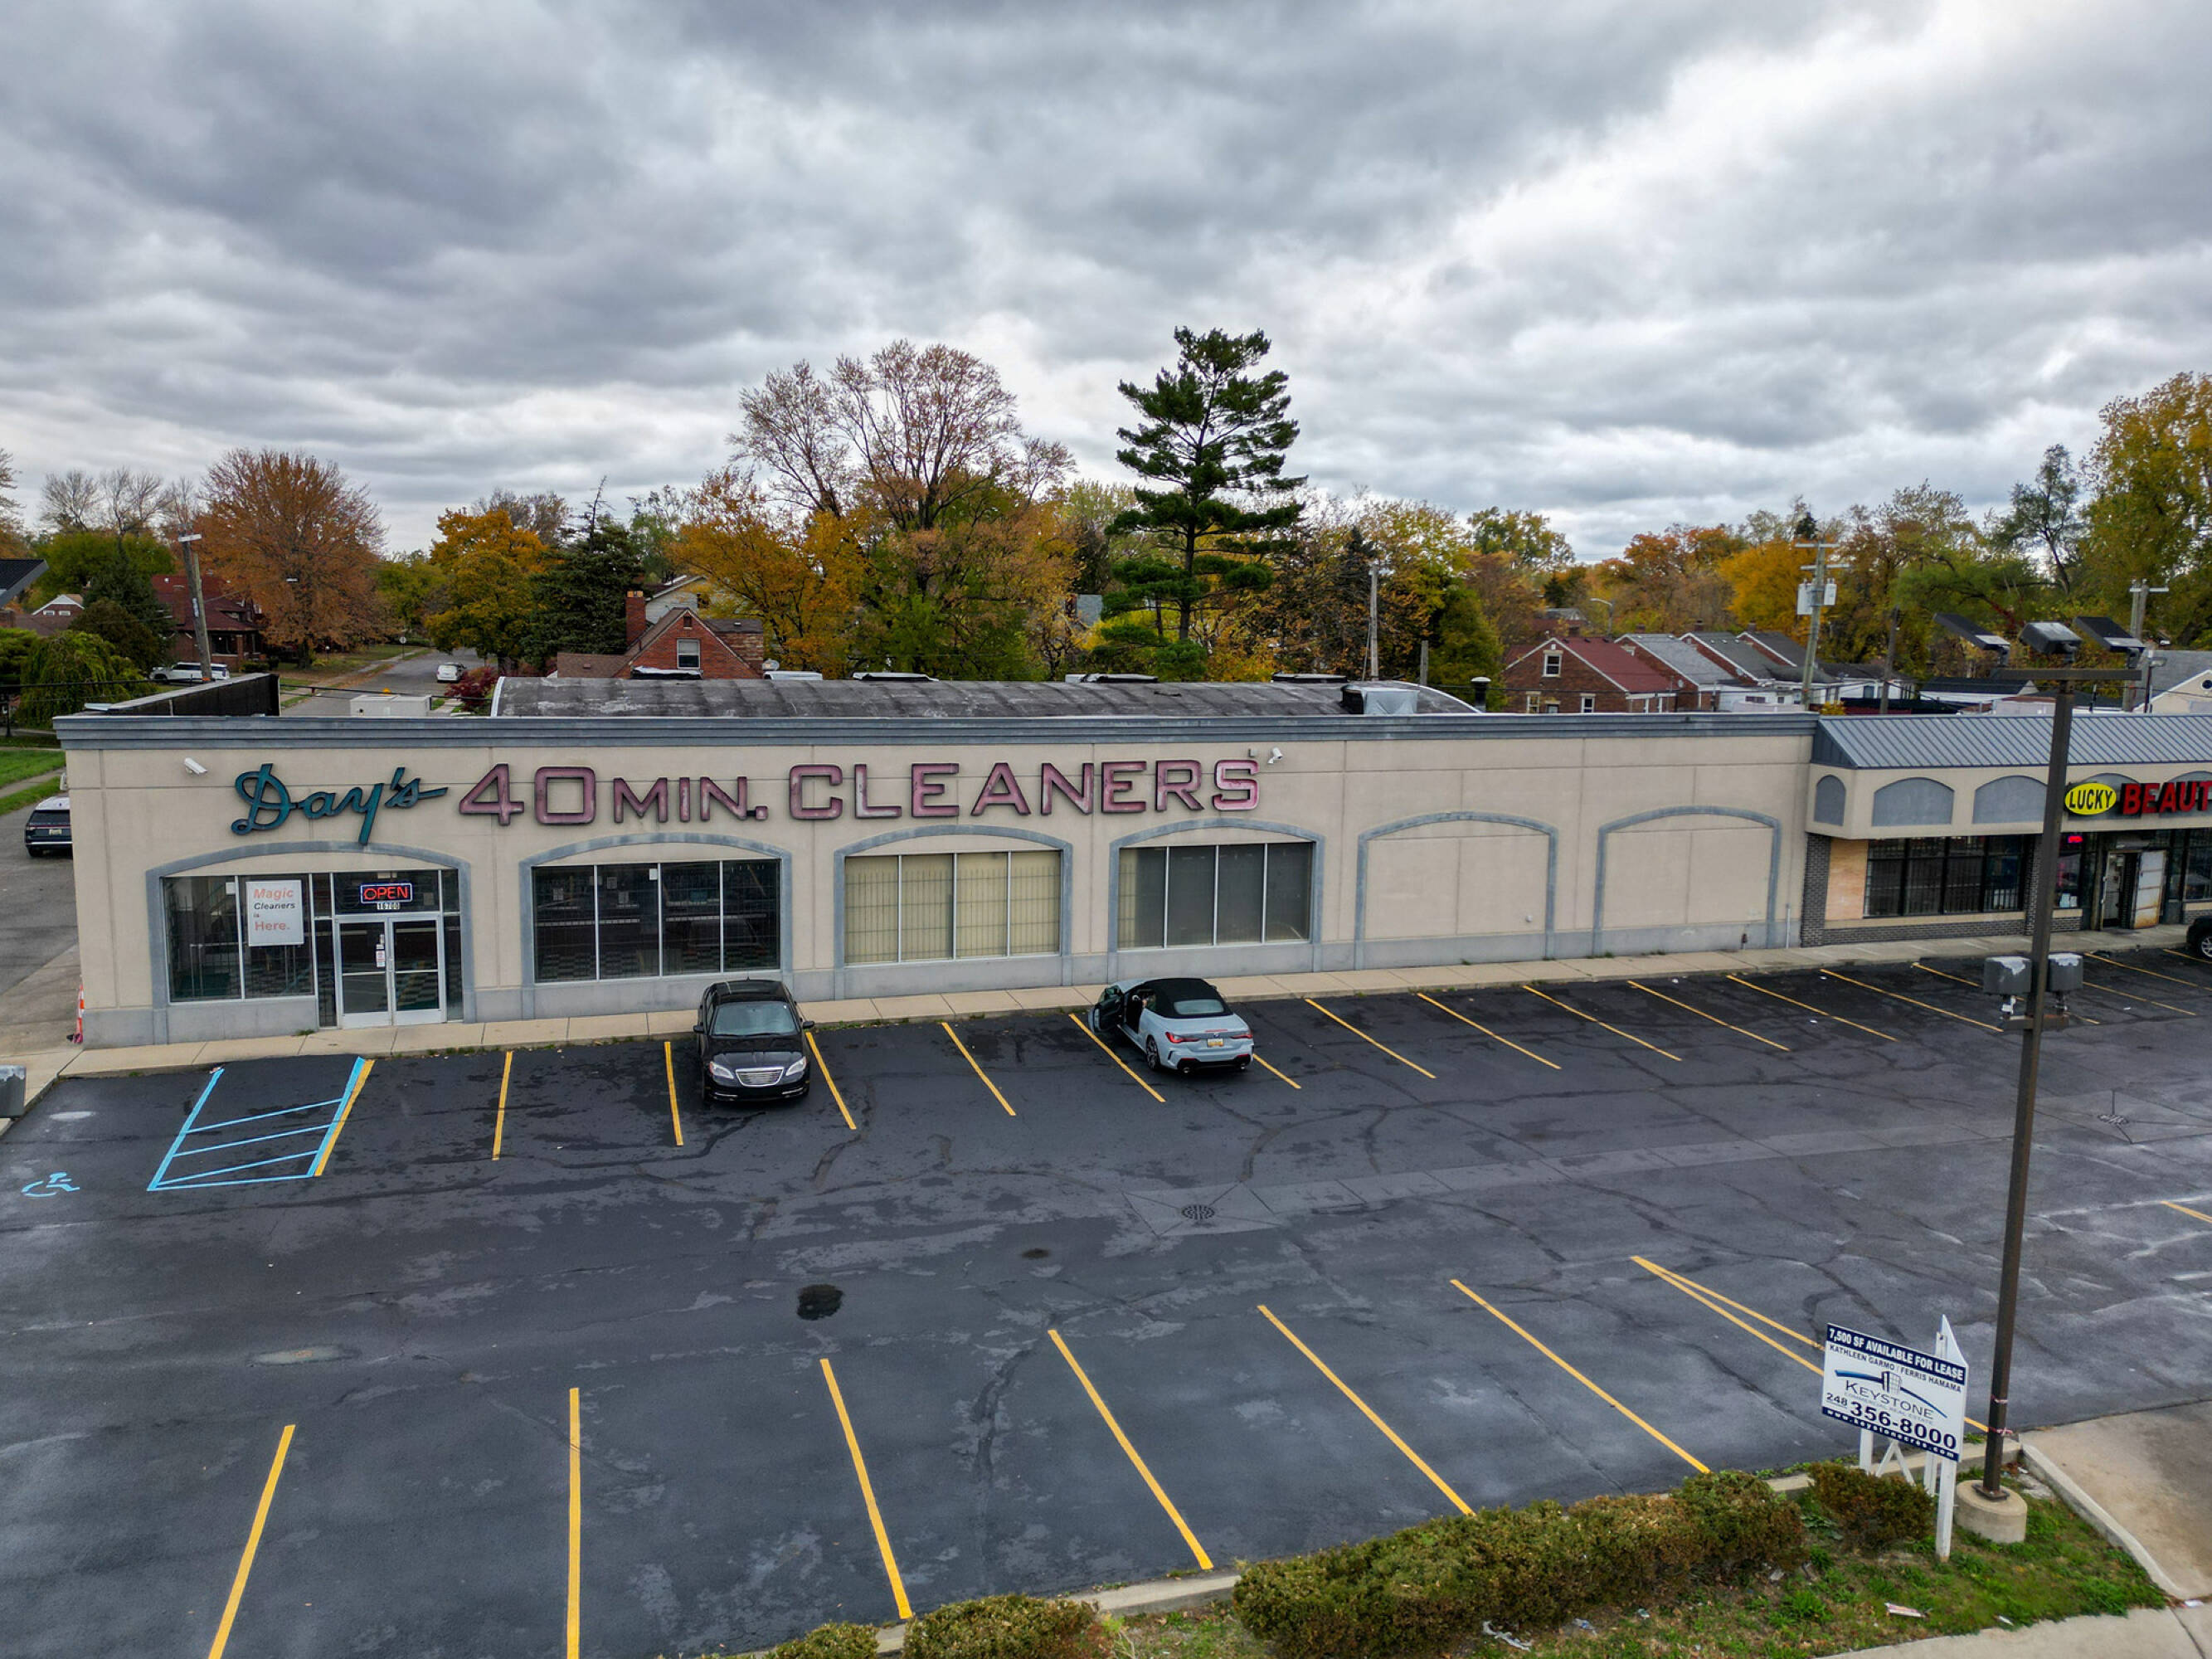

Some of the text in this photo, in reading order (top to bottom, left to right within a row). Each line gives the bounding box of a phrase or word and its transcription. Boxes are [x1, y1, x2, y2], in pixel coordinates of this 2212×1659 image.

[231, 759, 1260, 846] Day's 40 MIN. CLEANERS
[2069, 788, 2113, 810] LUCKY
[254, 887, 294, 901] Magic
[363, 886, 409, 901] OPEN
[254, 902, 296, 910] Cleaners
[1829, 1328, 1962, 1380] 7,500 SF AVAILABLE FOR LEASE
[1830, 1345, 1867, 1361] KATHLEEN
[1845, 1380, 1933, 1419] KEYSTONE
[1826, 1393, 1957, 1450] 248 356-8000
